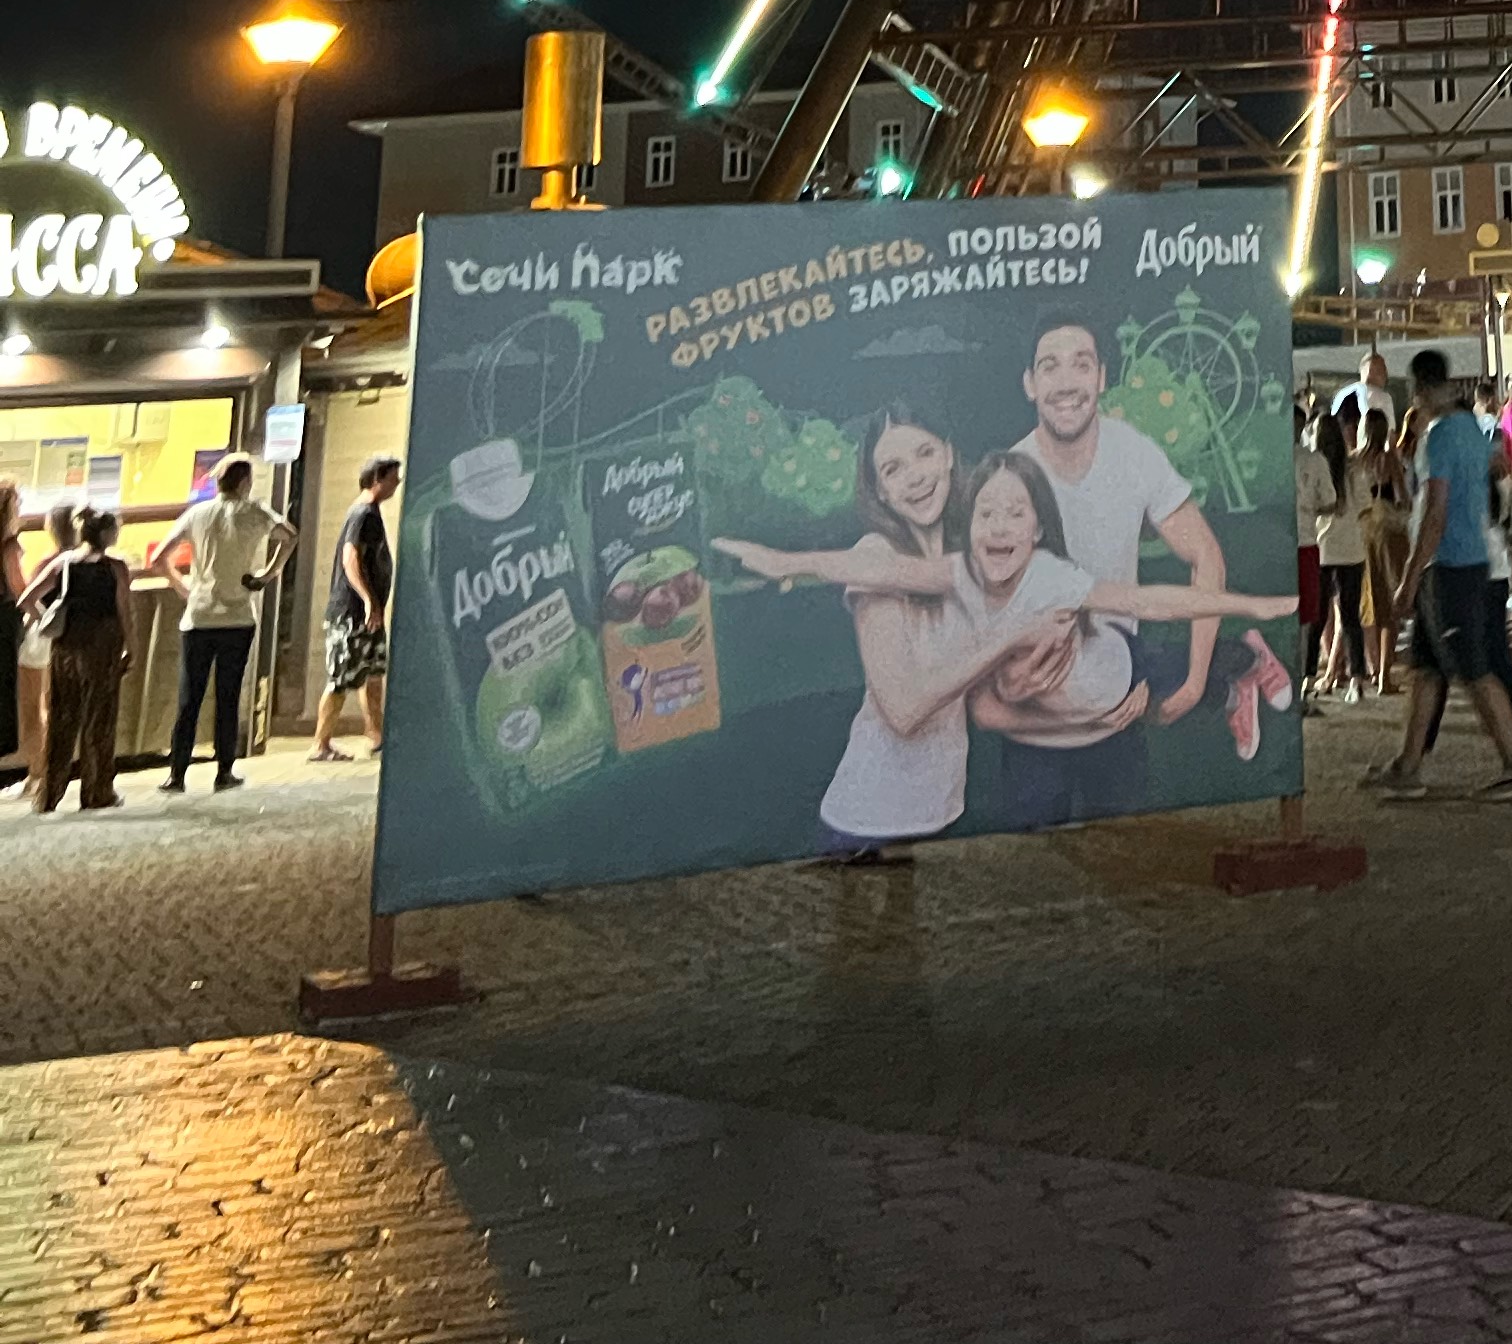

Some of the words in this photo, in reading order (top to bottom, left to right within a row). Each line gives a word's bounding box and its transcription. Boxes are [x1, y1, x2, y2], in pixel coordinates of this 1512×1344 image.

[645, 236, 934, 344] РАЗВЛЕКАЙТЕСЬ,
[948, 216, 1102, 259] ПОЛЬЗОЙ
[1136, 221, 1263, 278] Добрый
[670, 293, 837, 369] ФРУКТОВ
[848, 257, 1090, 313] ЗАРЯЖАЙТЕСЬ!
